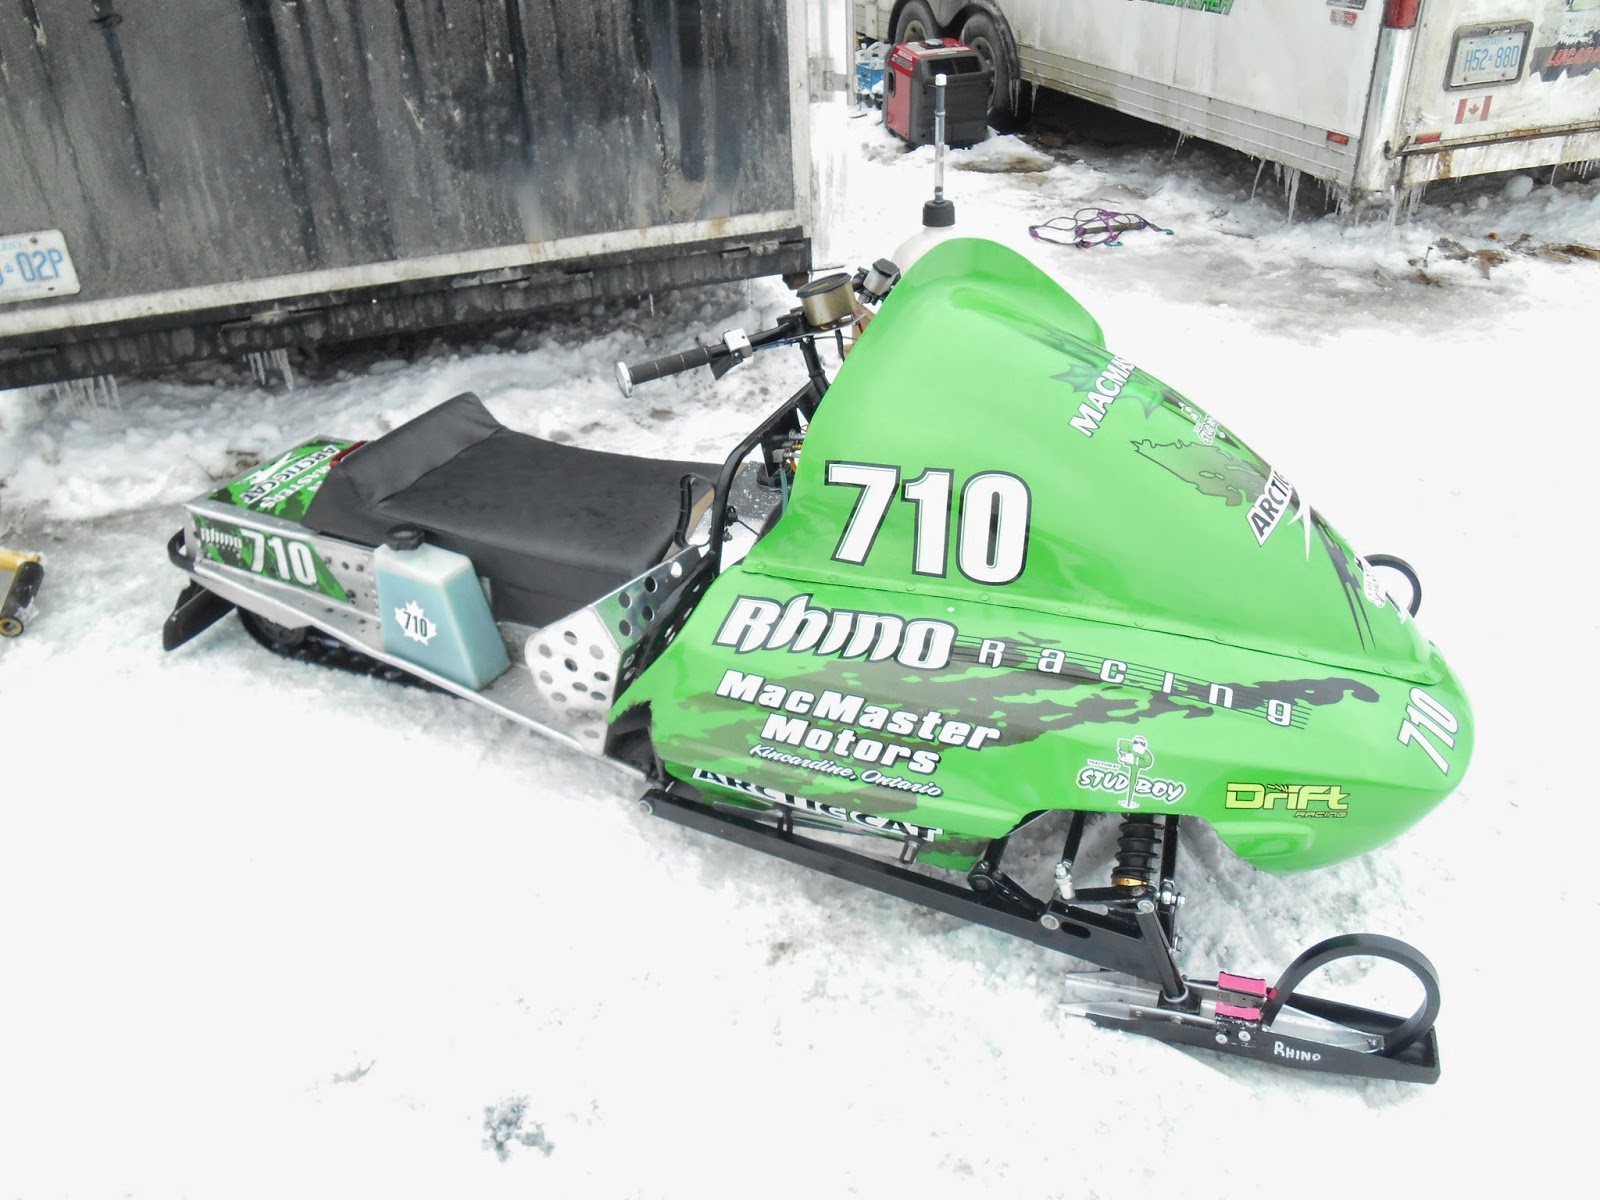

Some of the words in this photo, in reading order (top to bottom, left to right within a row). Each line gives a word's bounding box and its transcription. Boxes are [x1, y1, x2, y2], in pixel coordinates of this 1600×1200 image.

[242, 480, 278, 502] CAT
[274, 446, 338, 481] ARCTIC
[823, 460, 1032, 586] 710
[241, 526, 318, 586] 710
[403, 610, 428, 638] 710
[712, 593, 958, 670] Rhino
[715, 668, 1001, 750] MacMaster
[1397, 686, 1458, 777] 710
[748, 743, 859, 782] Kincardine,
[860, 769, 944, 798] Ontario
[760, 712, 942, 775] Motors
[1079, 768, 1129, 792] STUD
[1135, 778, 1184, 802] BOY
[1225, 782, 1350, 810] Drift
